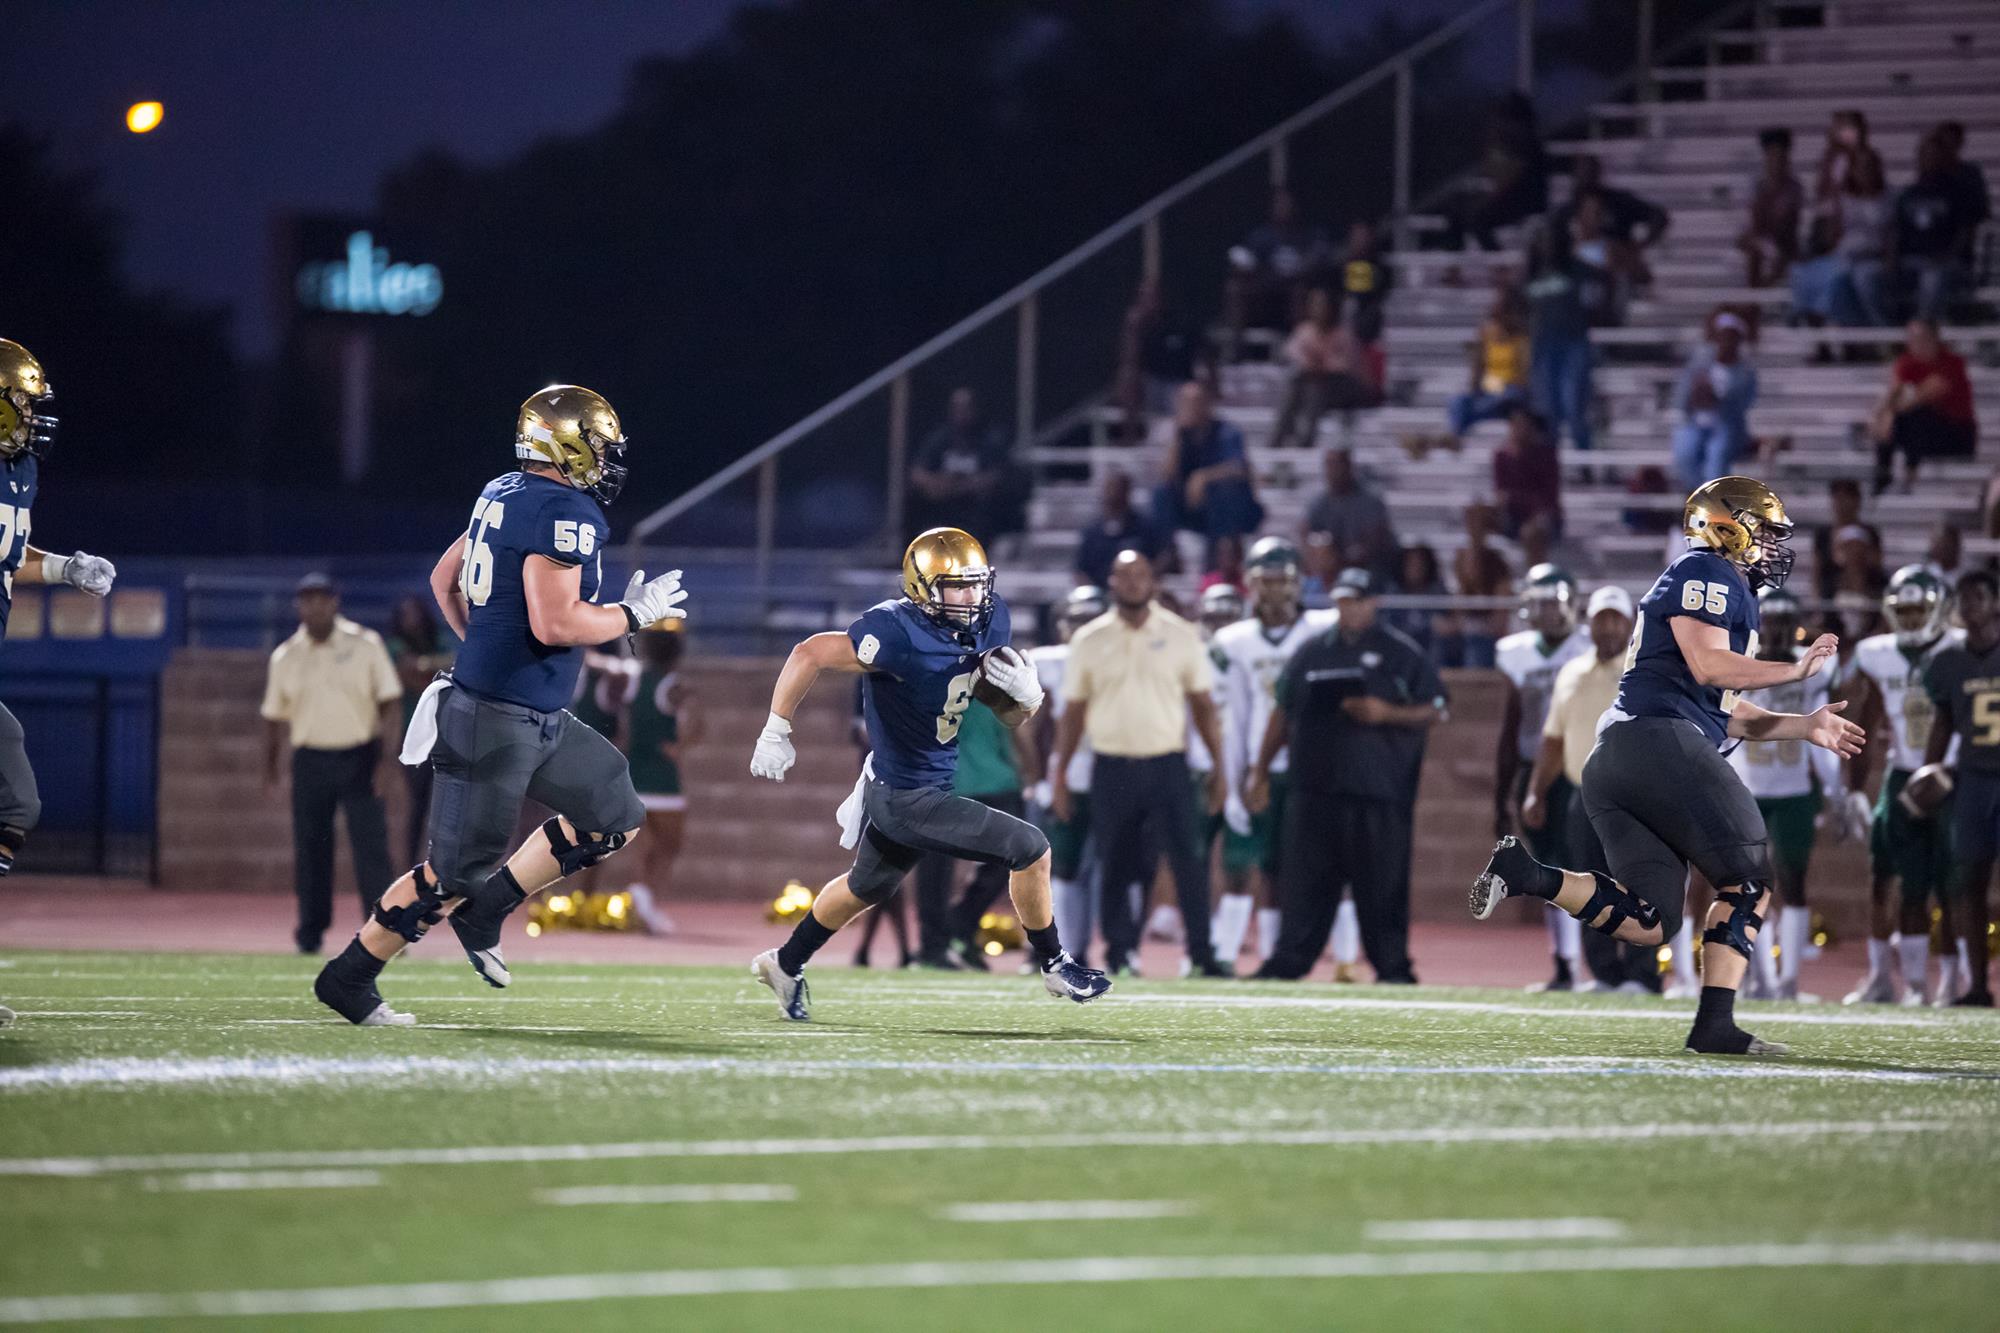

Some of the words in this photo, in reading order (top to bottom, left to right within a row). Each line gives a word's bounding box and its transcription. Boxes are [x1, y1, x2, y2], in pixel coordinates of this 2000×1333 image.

[554, 519, 596, 556] 56
[1681, 579, 1729, 615] 65
[857, 633, 881, 664] 8
